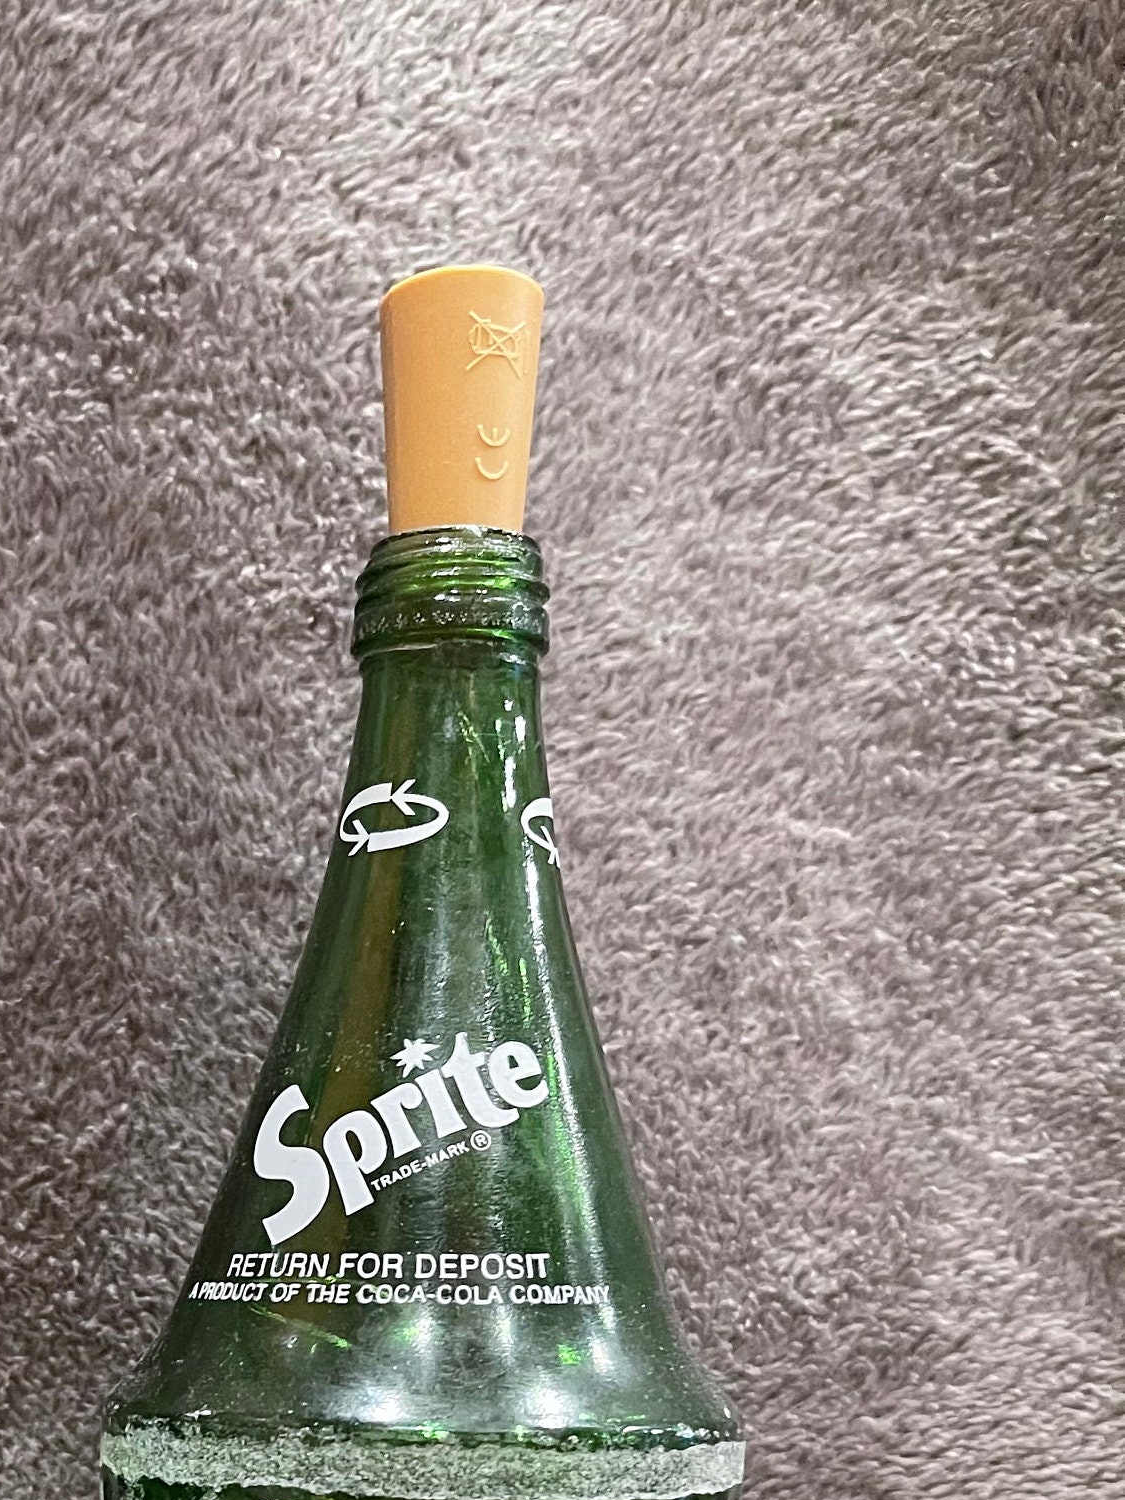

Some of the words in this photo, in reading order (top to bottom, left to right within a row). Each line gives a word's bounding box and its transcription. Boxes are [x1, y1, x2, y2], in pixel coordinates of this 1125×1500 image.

[254, 1031, 549, 1246] Sprite
[370, 1141, 470, 1191] TRADE-MARK
[226, 1253, 329, 1278] RETURN
[339, 1253, 403, 1279] FOR
[415, 1253, 550, 1280] DEPOSIT
[188, 1282, 199, 1299] A
[198, 1282, 269, 1301] PRODUCT
[269, 1283, 301, 1303] OF
[306, 1284, 351, 1304] THE
[356, 1284, 504, 1305] COCA-COLA
[509, 1284, 610, 1305] COMPANY
